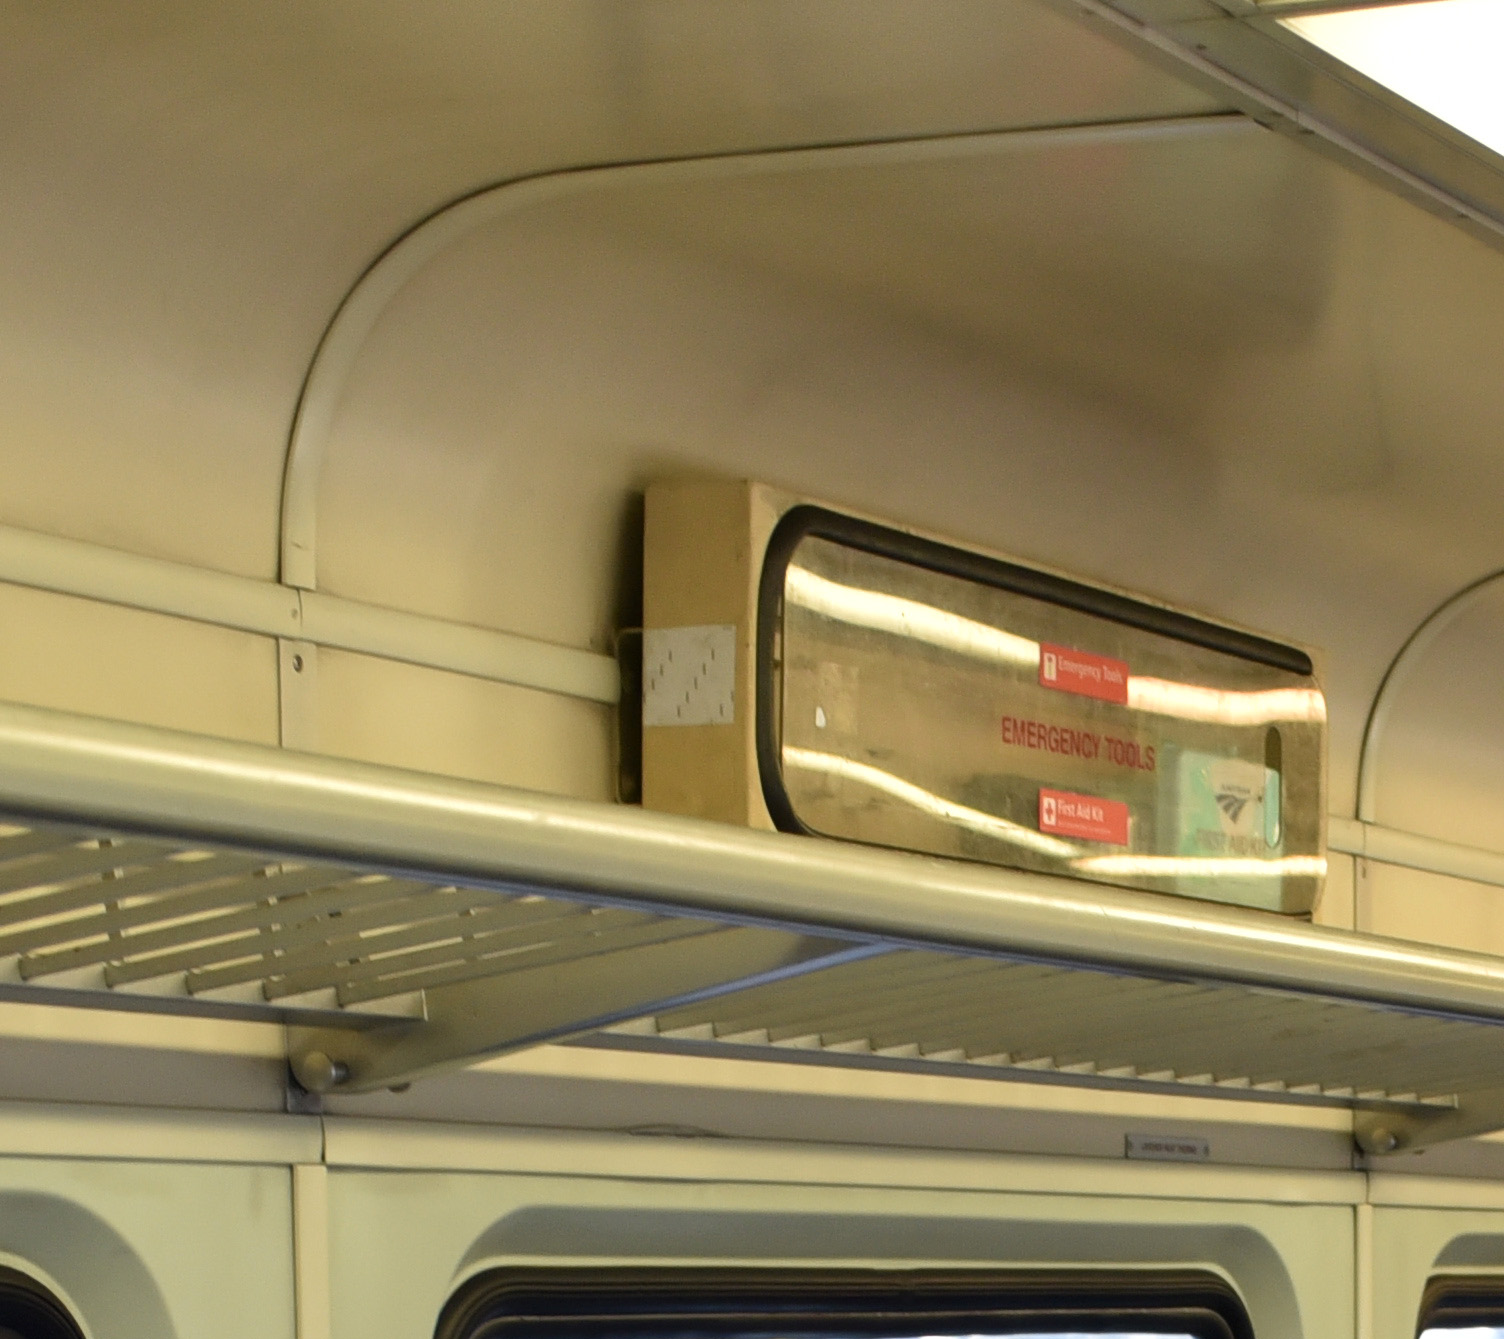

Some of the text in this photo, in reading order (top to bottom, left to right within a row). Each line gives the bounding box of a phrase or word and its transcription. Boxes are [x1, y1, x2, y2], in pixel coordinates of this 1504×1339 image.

[1002, 716, 1156, 771] EMERGENCY TOOLS
[1057, 799, 1104, 823] First Aid Kit
